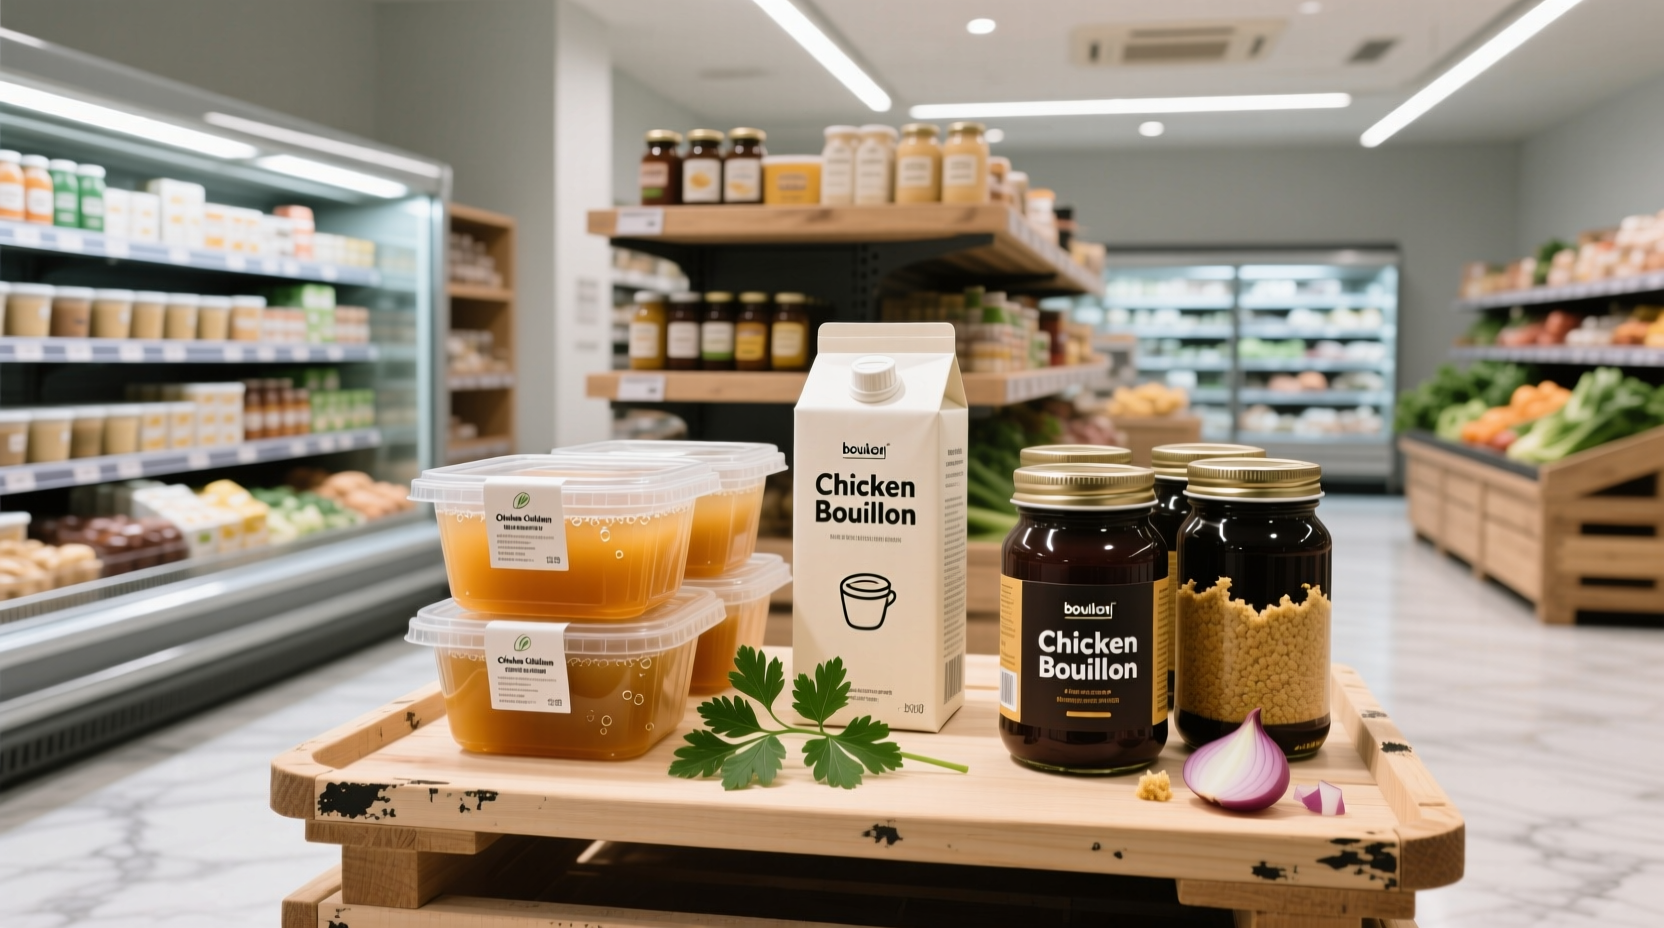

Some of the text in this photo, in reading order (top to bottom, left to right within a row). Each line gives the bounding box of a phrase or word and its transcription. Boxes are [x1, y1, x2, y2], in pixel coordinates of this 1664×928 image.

[815, 472, 915, 497] Chicken
[815, 500, 916, 525] Bouillon
[1038, 629, 1138, 655] Chicken
[1038, 655, 1138, 681] Bouillon
